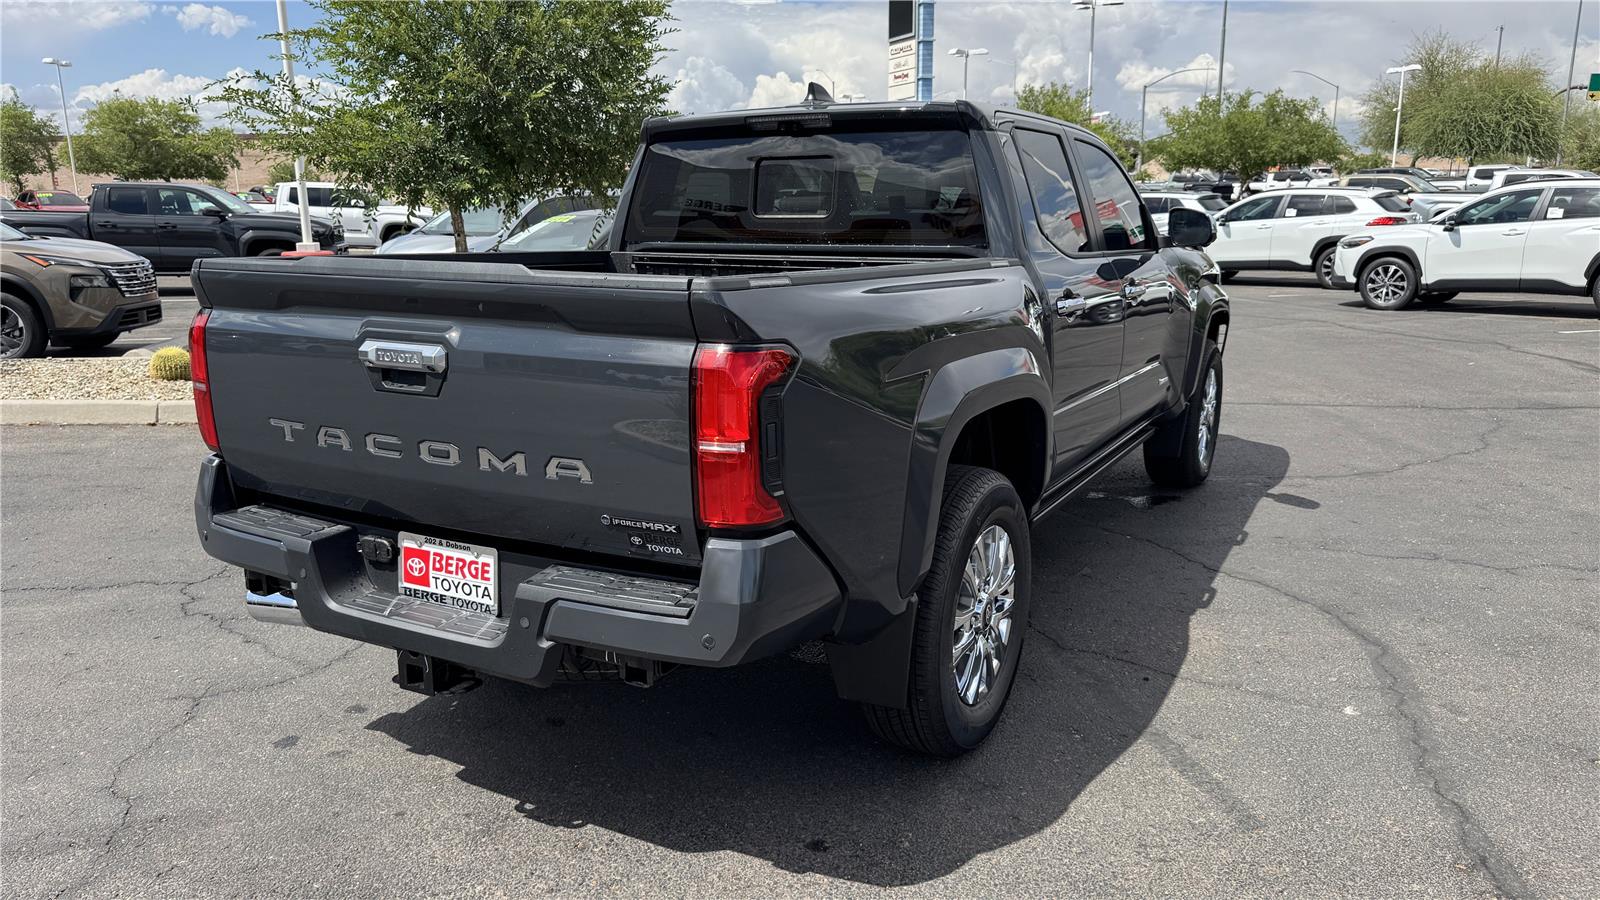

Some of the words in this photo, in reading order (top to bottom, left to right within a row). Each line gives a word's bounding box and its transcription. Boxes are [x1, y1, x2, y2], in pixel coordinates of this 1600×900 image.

[377, 351, 420, 364] TOYOTA
[269, 417, 593, 484] TACOMA
[424, 537, 437, 545] 202
[446, 541, 471, 551] Dobson
[646, 544, 683, 555] TOYOTA
[432, 551, 491, 581] BERGE
[404, 587, 447, 604] BERGE
[450, 596, 492, 614] TOYOTA
[432, 576, 492, 601] TOYOTA
